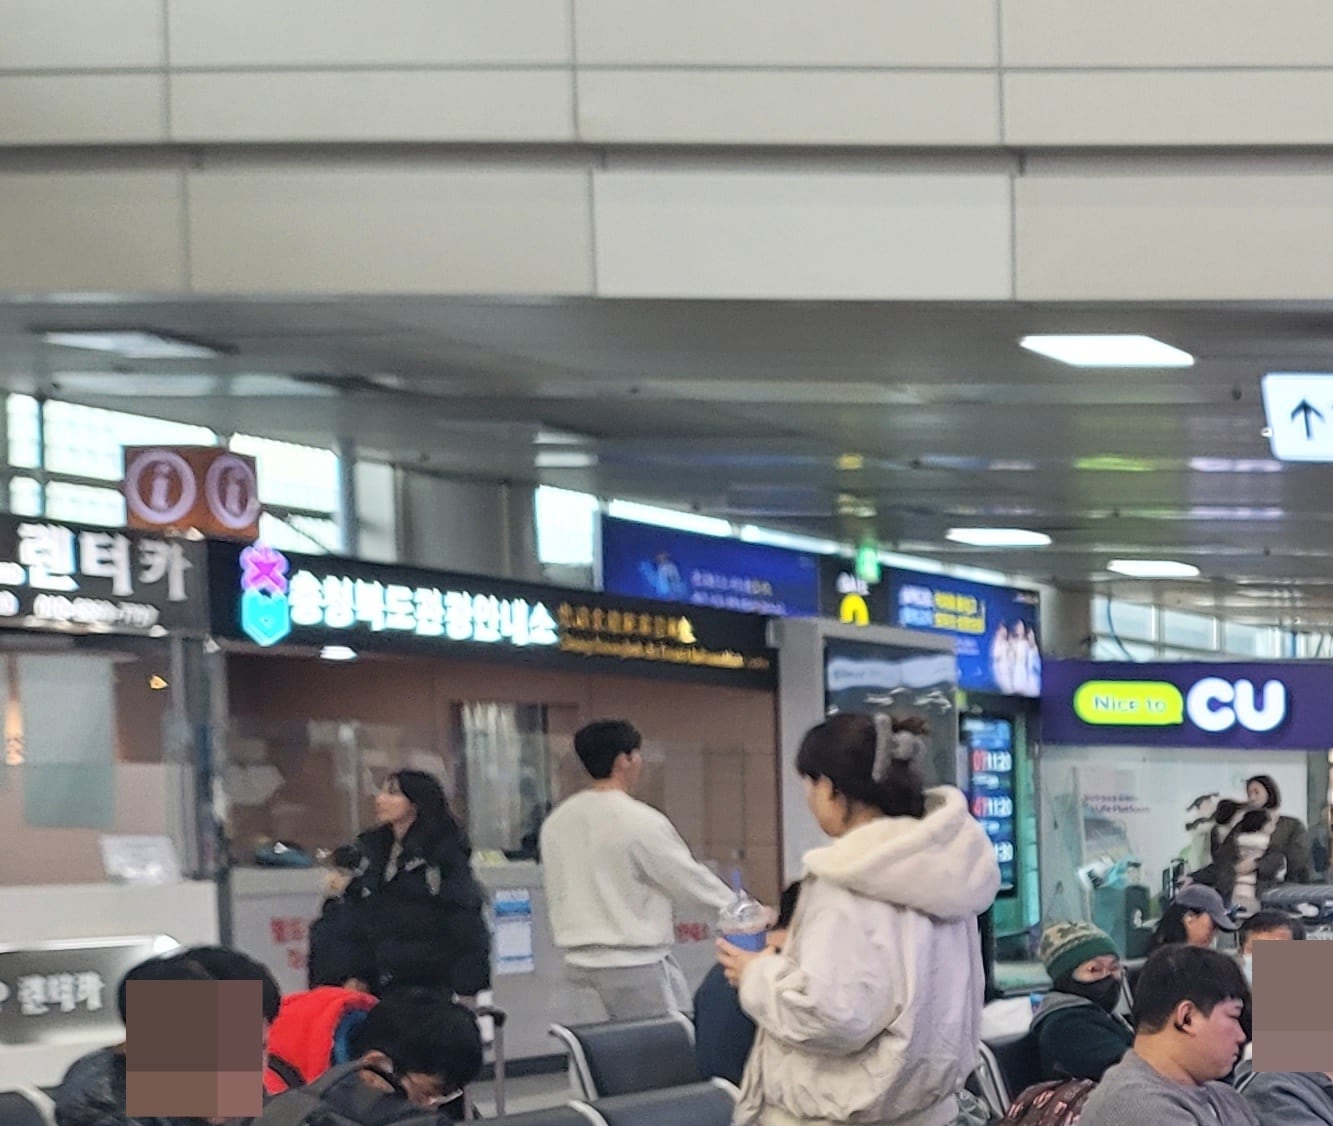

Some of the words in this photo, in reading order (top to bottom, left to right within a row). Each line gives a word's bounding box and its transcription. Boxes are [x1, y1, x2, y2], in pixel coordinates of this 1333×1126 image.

[17, 522, 194, 601] 렌터카
[1146, 695, 1167, 713] to
[1187, 677, 1286, 732] CU
